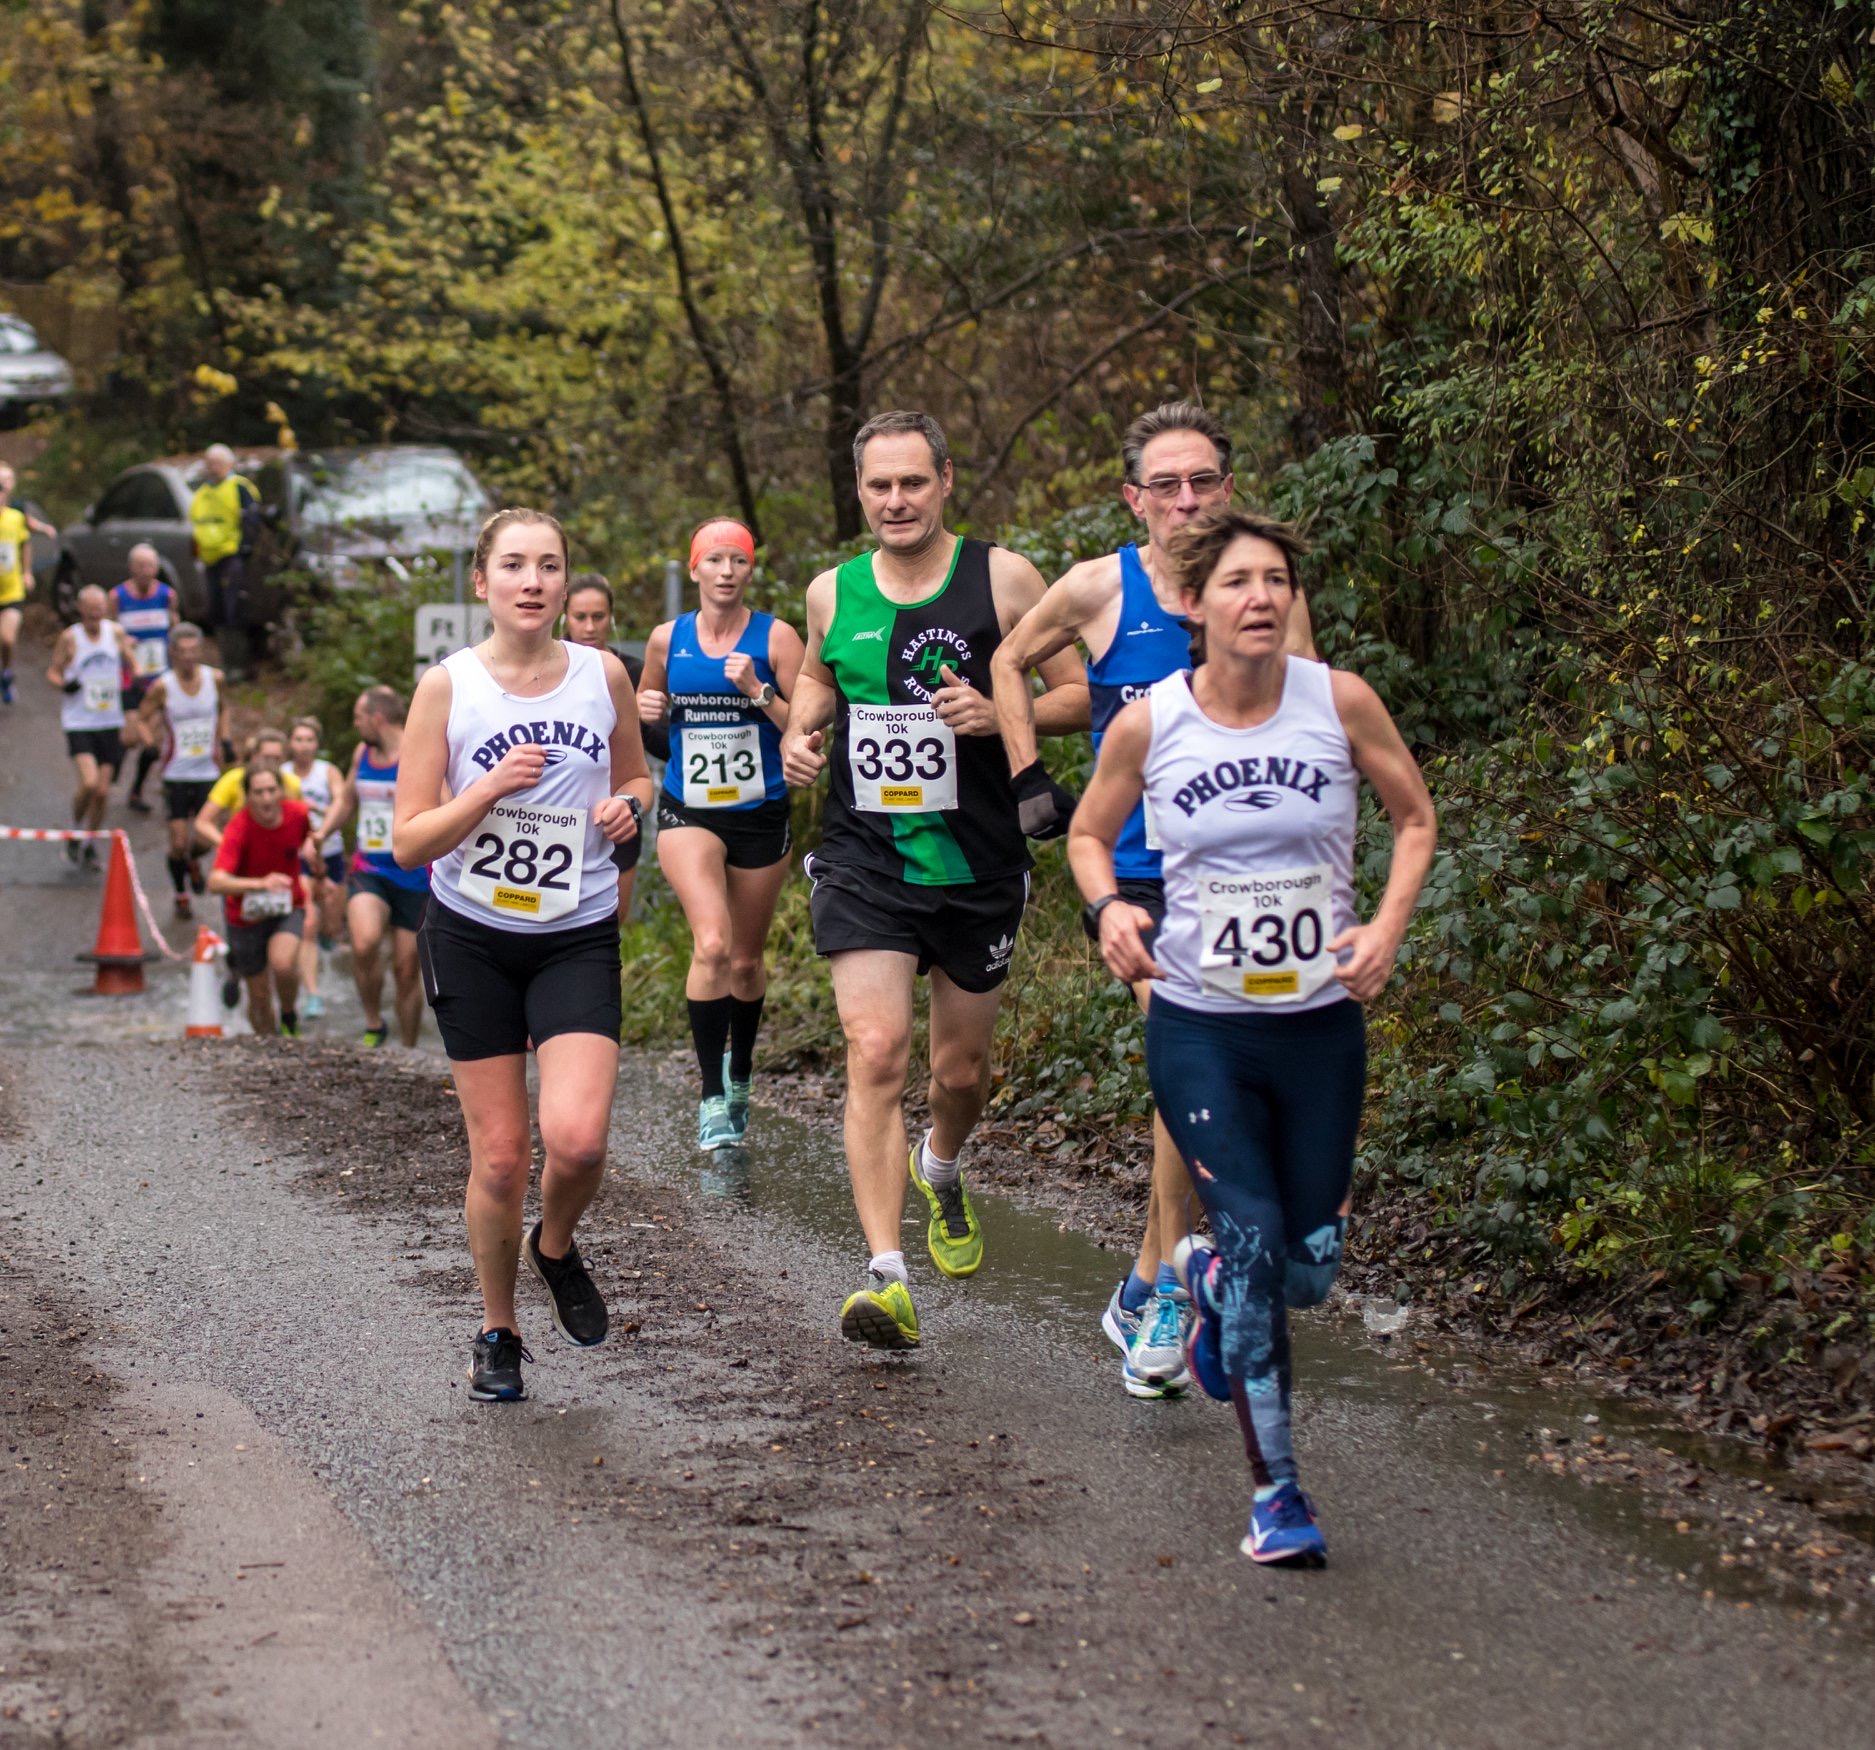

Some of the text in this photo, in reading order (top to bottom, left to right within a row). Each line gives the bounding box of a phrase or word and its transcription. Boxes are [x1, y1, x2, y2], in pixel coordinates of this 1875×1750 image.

[902, 628, 972, 662] HASTINGS
[904, 676, 970, 703] RUNS
[685, 709, 741, 722] Runners
[857, 709, 938, 722] Crowboroug
[688, 729, 752, 741] Crowborough
[886, 723, 908, 734] 10k
[471, 720, 606, 772] PHOENIX
[689, 749, 756, 784] 213
[856, 737, 947, 781] 333
[1172, 756, 1332, 818] PHOENIX
[490, 806, 577, 828] rowborough
[516, 822, 540, 836] 10k
[470, 832, 573, 891] 282
[1209, 874, 1322, 894] Crowborough
[497, 891, 537, 904] COPPARD
[1253, 894, 1283, 908] 10k
[1212, 908, 1323, 967] 430
